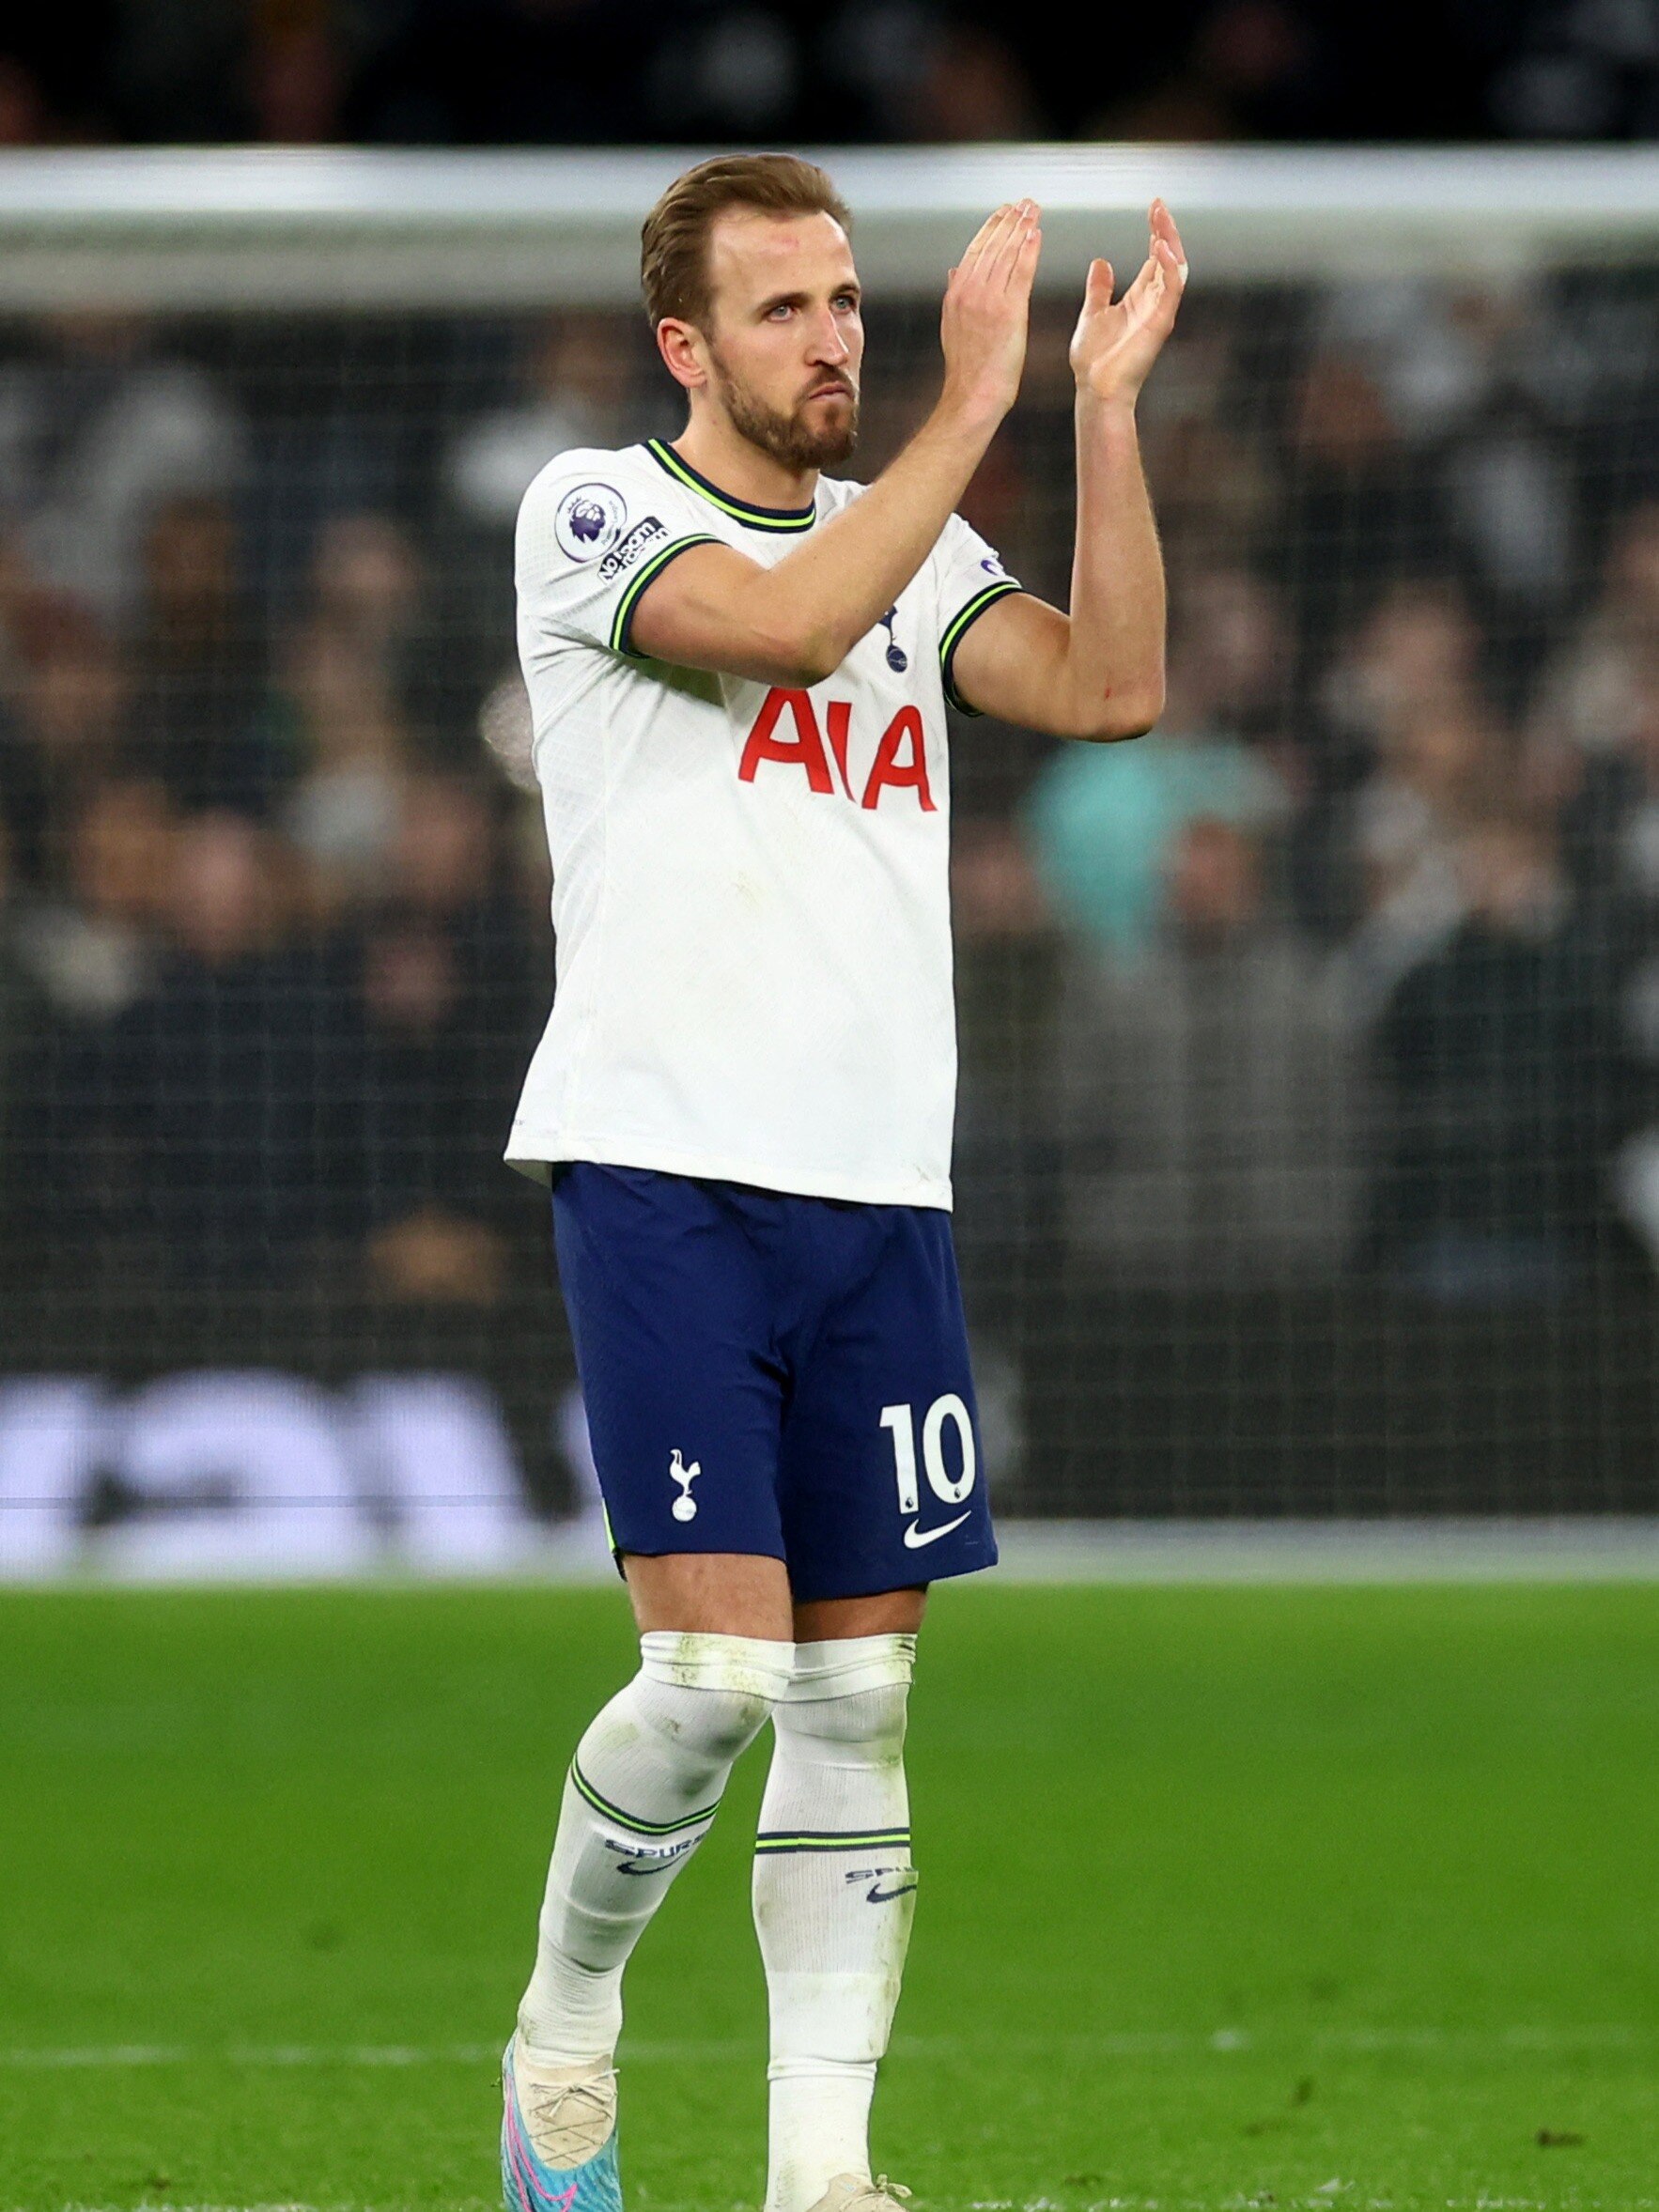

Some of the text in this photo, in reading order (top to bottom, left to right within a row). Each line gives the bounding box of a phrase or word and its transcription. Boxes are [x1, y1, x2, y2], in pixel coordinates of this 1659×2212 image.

[598, 558, 618, 581] No
[738, 687, 938, 812] AIA
[879, 1393, 976, 1514] 10
